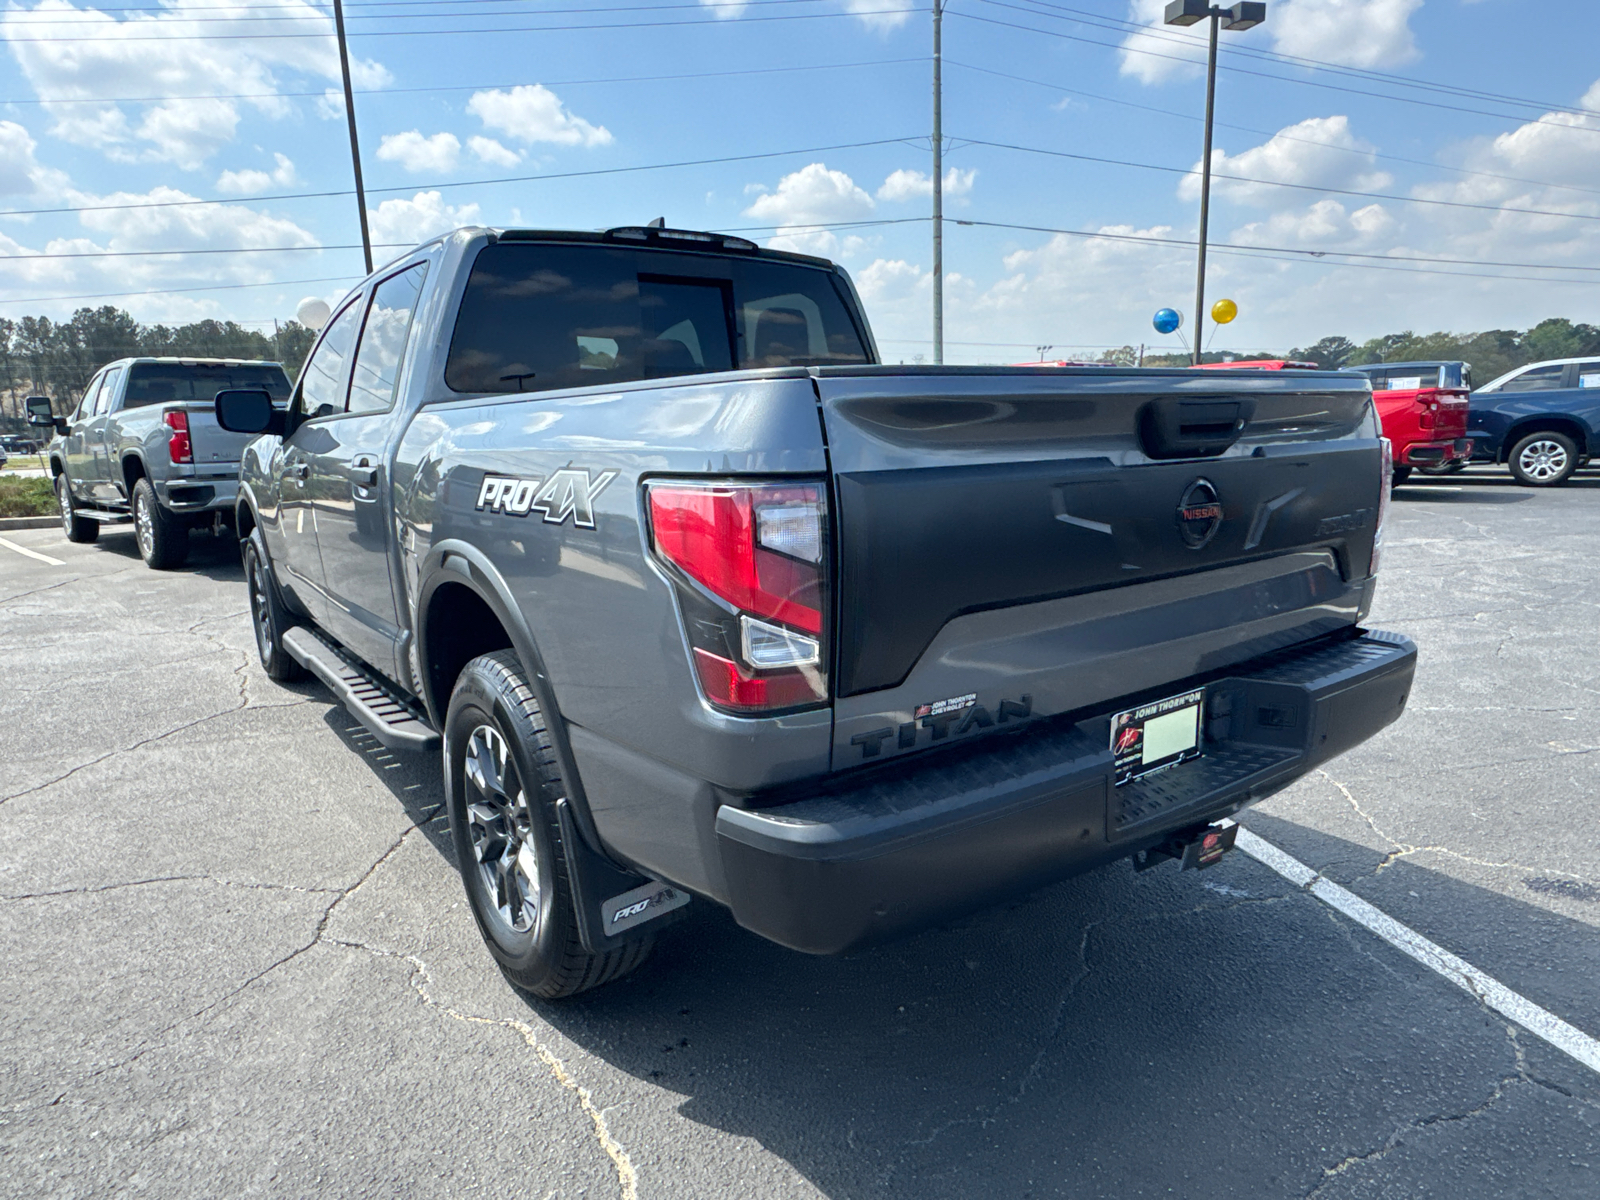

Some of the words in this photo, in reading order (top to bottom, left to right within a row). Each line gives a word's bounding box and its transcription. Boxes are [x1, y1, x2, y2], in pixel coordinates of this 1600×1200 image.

[1183, 506, 1219, 520] NISSAN
[931, 700, 947, 710] JOHN
[947, 693, 977, 706] THORNTON
[931, 702, 965, 716] CHEVROLET
[1134, 704, 1158, 720] JOHN
[852, 694, 1032, 758] TITAN
